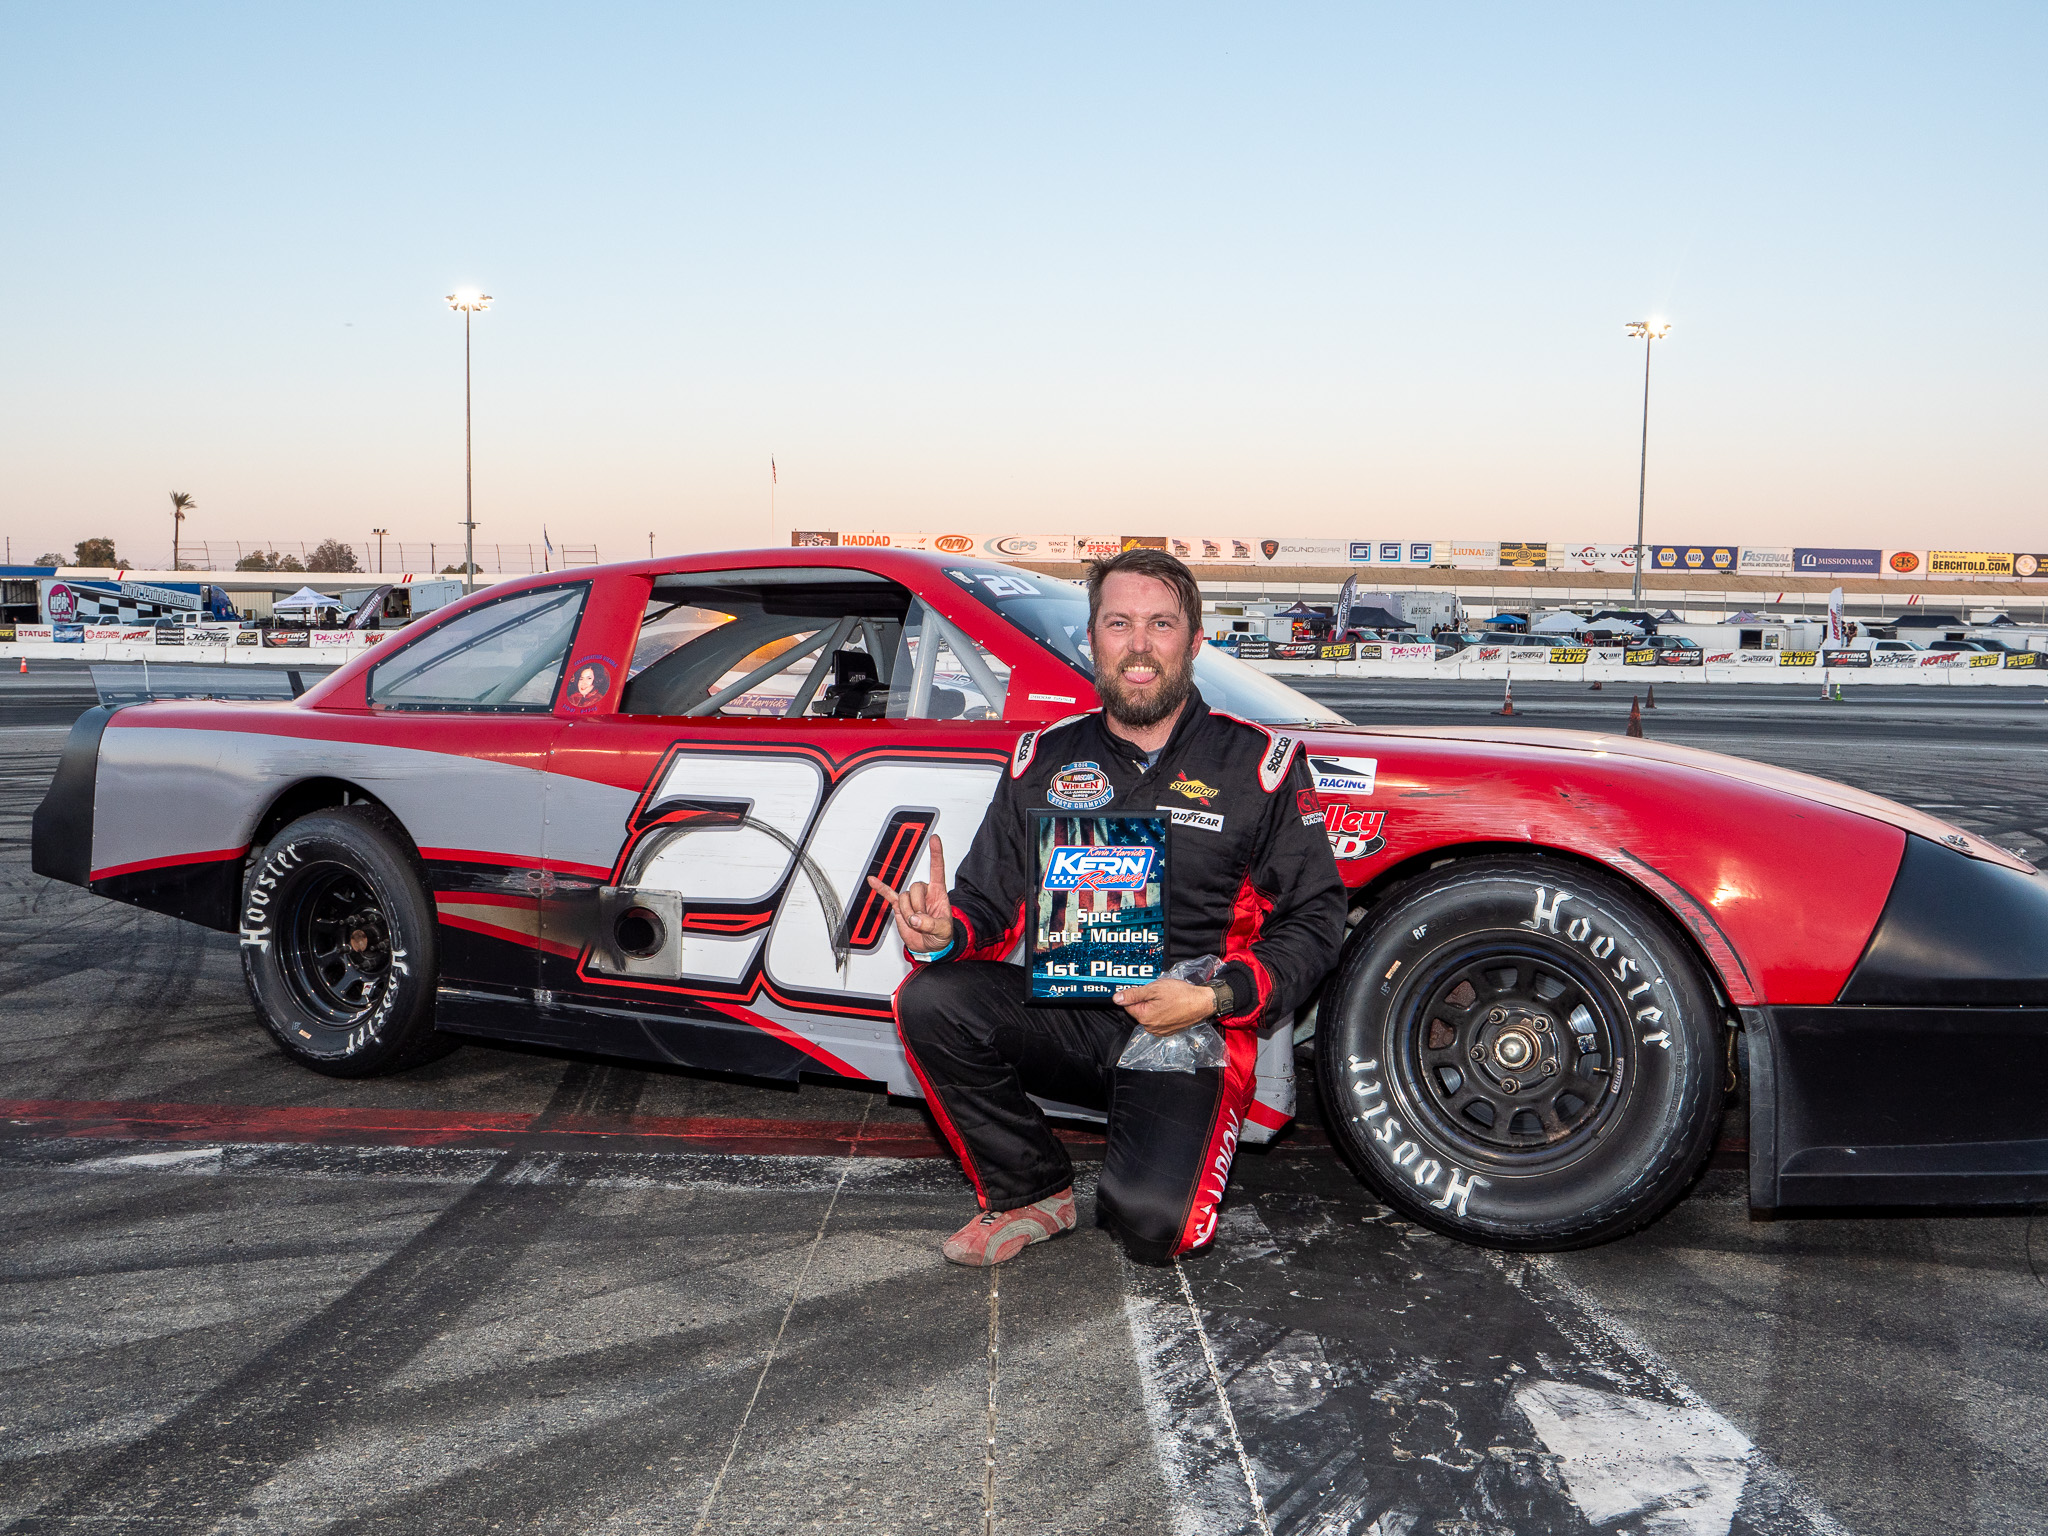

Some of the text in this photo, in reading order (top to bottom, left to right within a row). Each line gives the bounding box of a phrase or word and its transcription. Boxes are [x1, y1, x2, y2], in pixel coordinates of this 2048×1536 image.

[842, 535, 891, 546] HADDAD
[1009, 541, 1037, 550] GPS
[1087, 544, 1120, 553] PEST
[1281, 546, 1341, 554] SOUNDGEAR
[1660, 553, 1675, 562] NAPA
[1687, 553, 1702, 562] NAPA
[1714, 553, 1729, 563] NAPA
[1818, 557, 1873, 566] MISSION BANK
[1932, 560, 2010, 571] BERCHTOLD.COM
[974, 574, 1041, 597] 20
[121, 583, 197, 608] High Point Racing
[1321, 649, 1350, 658] CLUB
[1550, 653, 1587, 663] CLUB
[1626, 654, 1654, 663] CLUB
[1780, 656, 1815, 665] CLUB
[1969, 658, 1998, 667] CLUB
[1267, 736, 1292, 774] sparco
[1073, 773, 1095, 782] NASCAR
[1319, 777, 1367, 789] RACING
[1061, 780, 1099, 790] WHELEN
[1171, 781, 1217, 797] SUNOCO
[1050, 794, 1110, 809] STATE CHAMPION
[1172, 811, 1220, 827] ODYEAR
[1323, 803, 1386, 842] lley
[1086, 846, 1110, 857] Kevin
[1052, 852, 1146, 875] KERN
[580, 750, 1004, 1003] 20
[1071, 870, 1145, 894] Raceway
[240, 844, 302, 953] Hoosier
[1077, 908, 1122, 925] Spec
[1037, 928, 1159, 943] Late Models
[1412, 924, 1428, 940] RF
[1045, 960, 1154, 977] 1st Place
[1520, 886, 1672, 1050] Hoosier
[1049, 984, 1078, 993] April
[1082, 984, 1111, 993] 19th,
[1347, 1053, 1492, 1217] Hoosier
